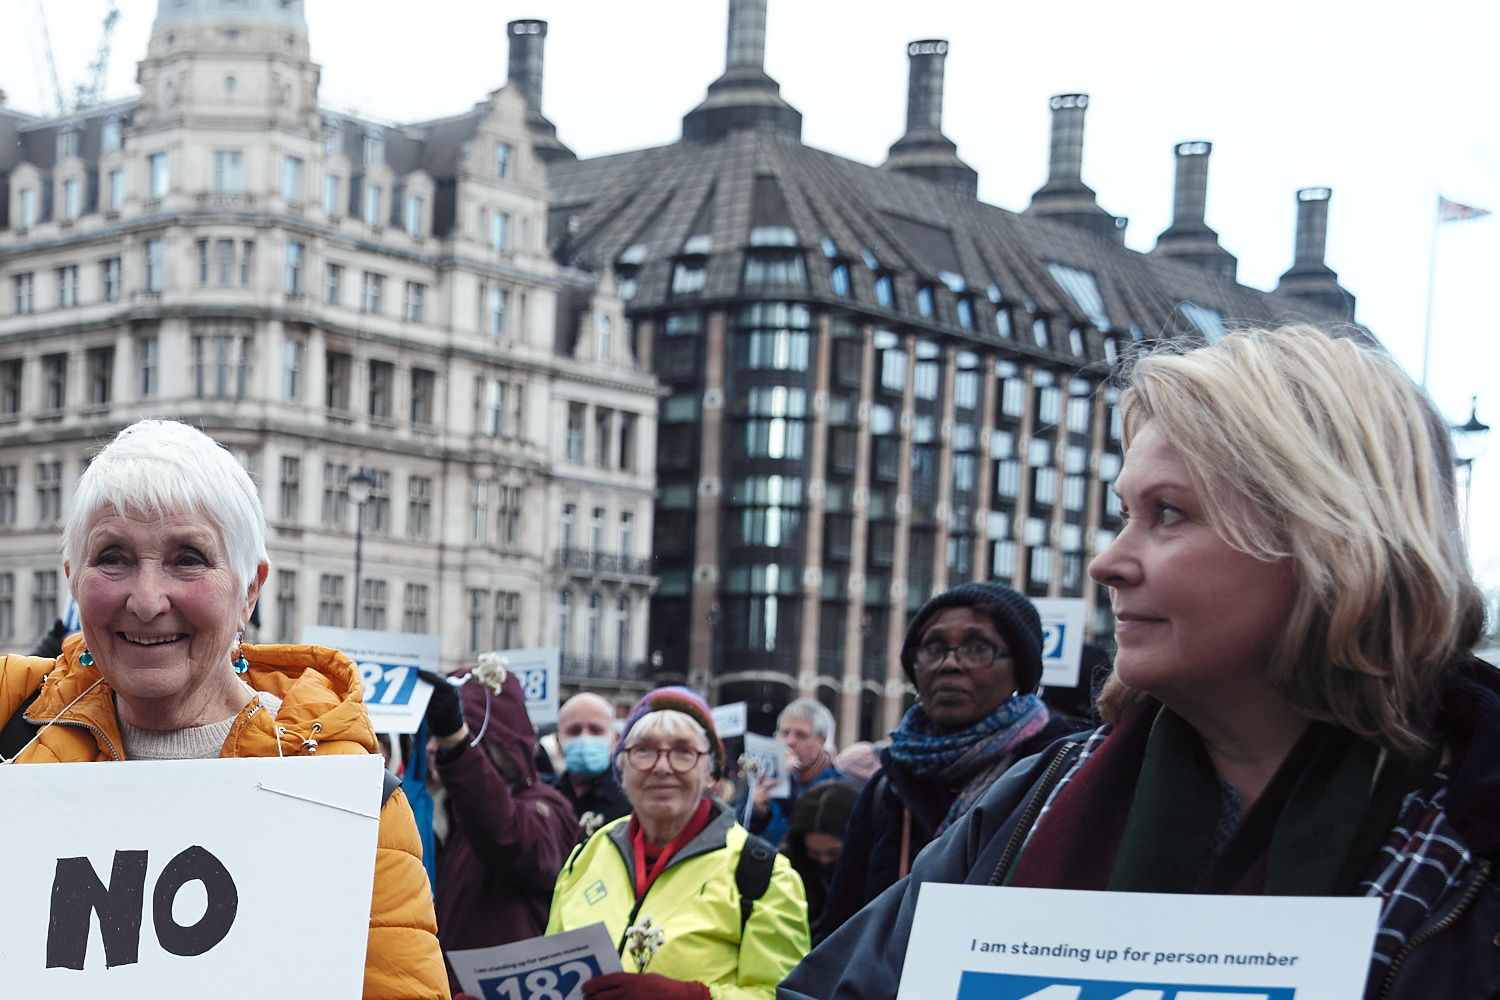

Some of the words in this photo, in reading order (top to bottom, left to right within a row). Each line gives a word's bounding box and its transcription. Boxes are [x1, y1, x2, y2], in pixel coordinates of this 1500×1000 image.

[358, 662, 410, 704] 81
[45, 845, 239, 970] NO
[970, 938, 976, 951] I
[980, 940, 1006, 953] am
[1010, 941, 1091, 962] standing
[1096, 948, 1118, 961] up
[1122, 947, 1150, 962] for
[1153, 951, 1219, 965] person
[1223, 951, 1299, 967] number
